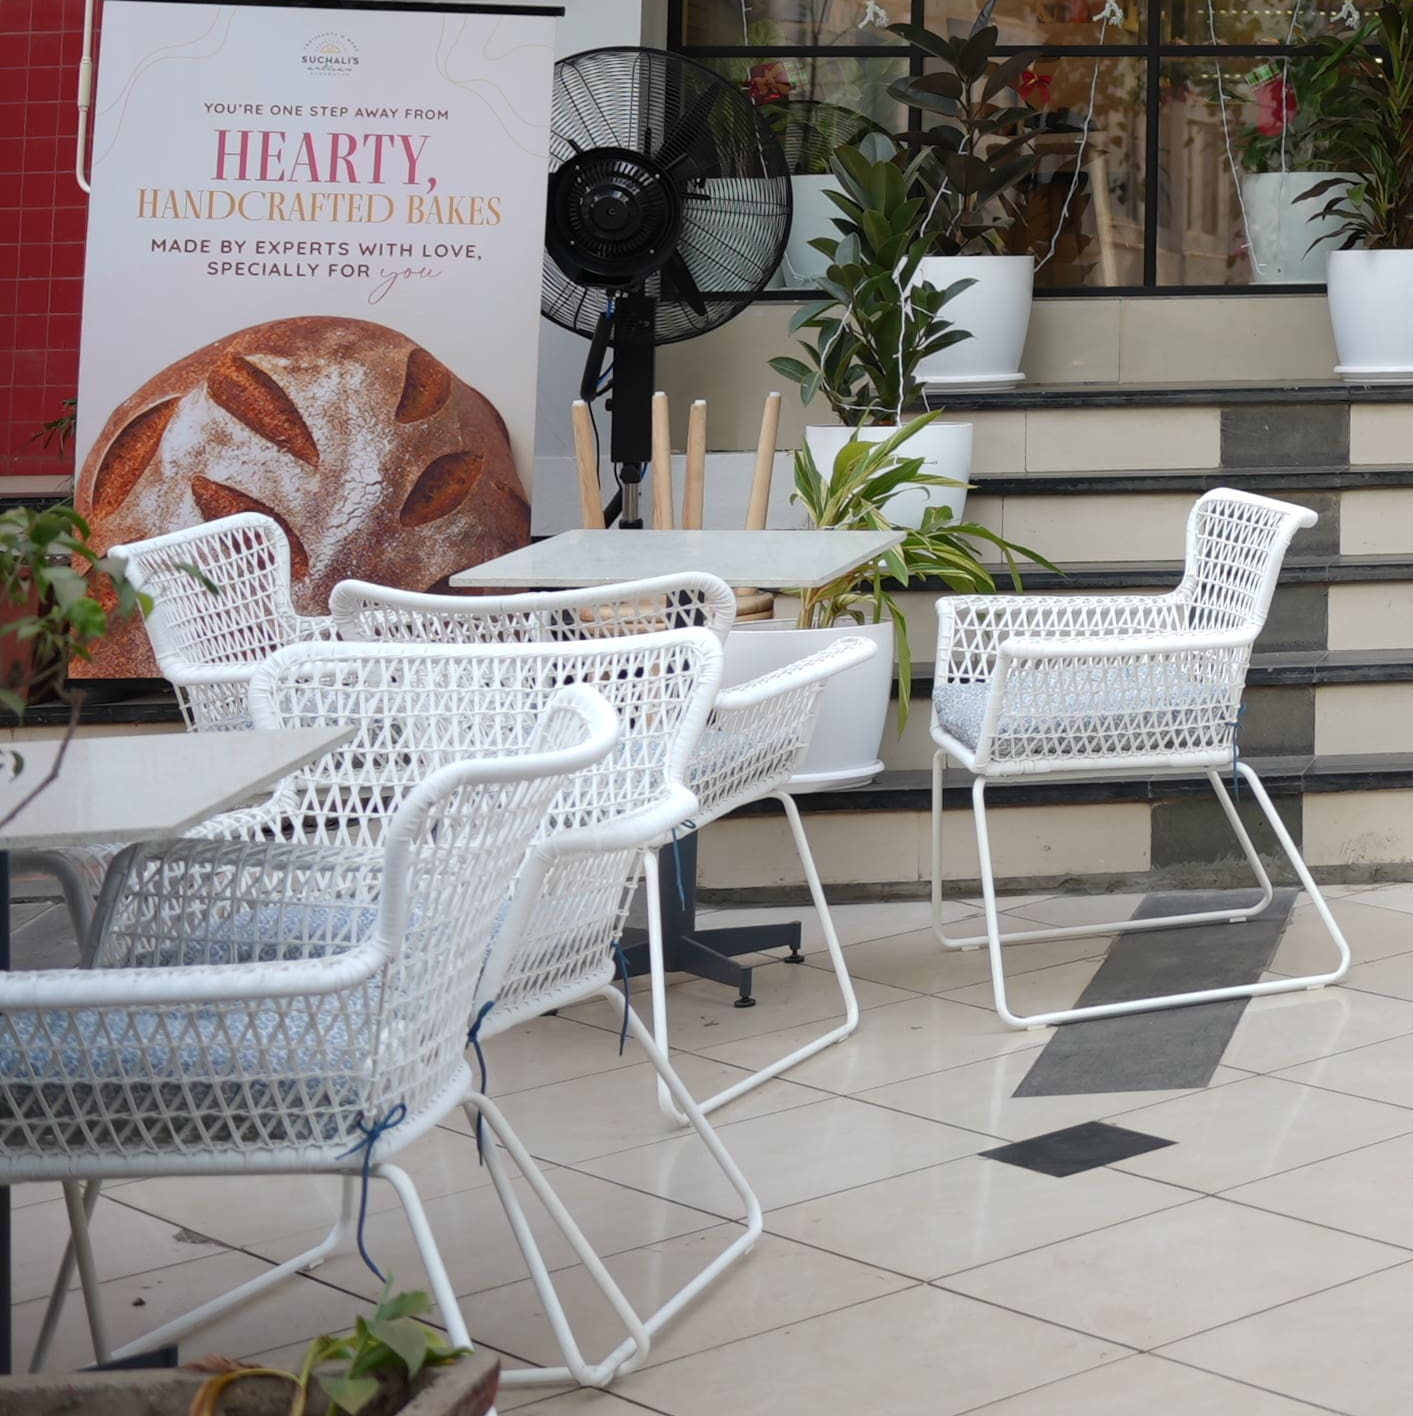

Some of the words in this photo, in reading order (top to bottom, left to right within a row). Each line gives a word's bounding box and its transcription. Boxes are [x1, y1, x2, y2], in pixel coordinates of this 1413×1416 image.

[301, 55, 360, 65] SUCHALI'S
[203, 102, 264, 117] YOU'RE
[269, 104, 304, 118] ONE
[309, 104, 349, 119] STEP
[354, 106, 399, 120] AWAY
[405, 107, 450, 121] FROM
[211, 128, 438, 195] HEARTY,
[136, 187, 395, 224] HANDCRAFTED
[406, 193, 503, 226] BAKES
[151, 238, 211, 255] MADE
[220, 239, 248, 255] BY
[255, 240, 350, 257] EXPERTS
[358, 241, 414, 258] WITH
[422, 242, 484, 261] LOVE,
[207, 261, 320, 278] SPECIALLY
[328, 262, 371, 279] FOR
[367, 264, 444, 305] you
